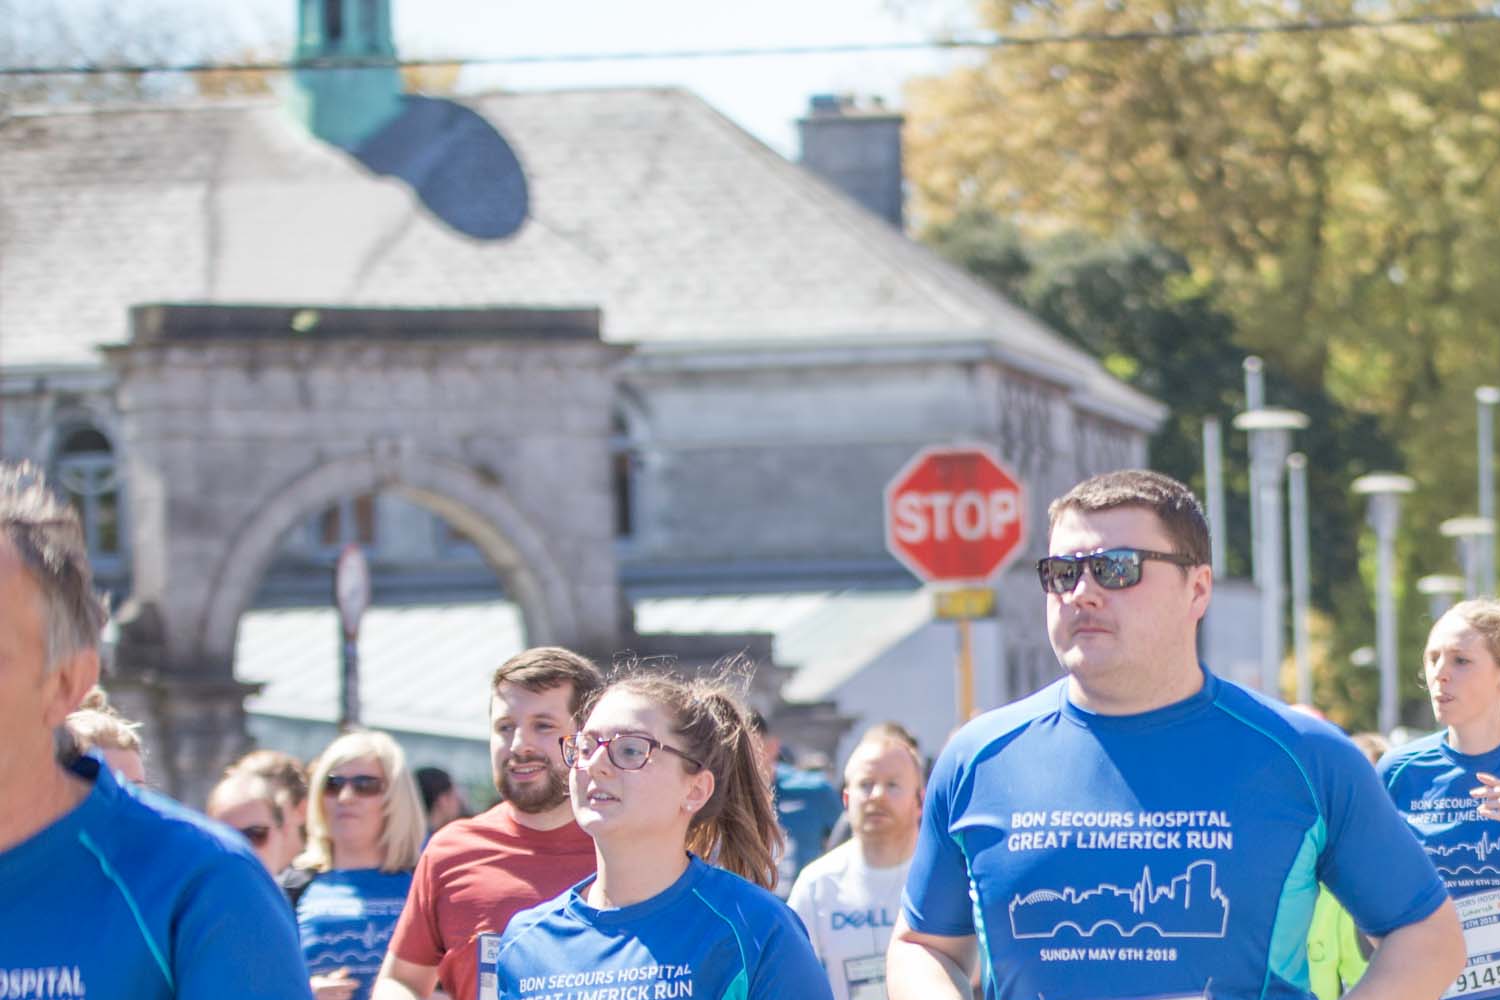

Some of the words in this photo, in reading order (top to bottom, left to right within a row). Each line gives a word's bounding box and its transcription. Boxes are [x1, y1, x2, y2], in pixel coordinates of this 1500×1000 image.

[896, 489, 1017, 543] STOP
[1410, 800, 1432, 811] BON
[1433, 798, 1479, 809] SECOURS
[1011, 811, 1046, 829] BON
[1050, 810, 1133, 828] SECOURS
[1138, 811, 1232, 828] HOSPITAL
[1447, 811, 1489, 822] LIMER
[1008, 831, 1072, 851] GREAT
[1076, 831, 1182, 850] LIMERICK
[1187, 832, 1233, 850] RUN
[832, 908, 894, 931] DELL
[1040, 949, 1086, 961] SUNDAY
[1088, 949, 1117, 961] MAY
[1118, 949, 1143, 961] 6TH
[1145, 949, 1178, 961] 2018
[519, 977, 545, 993] BON
[549, 969, 613, 989] SECOURS
[617, 963, 692, 984] HOSPITAL
[654, 979, 693, 1000] RUN
